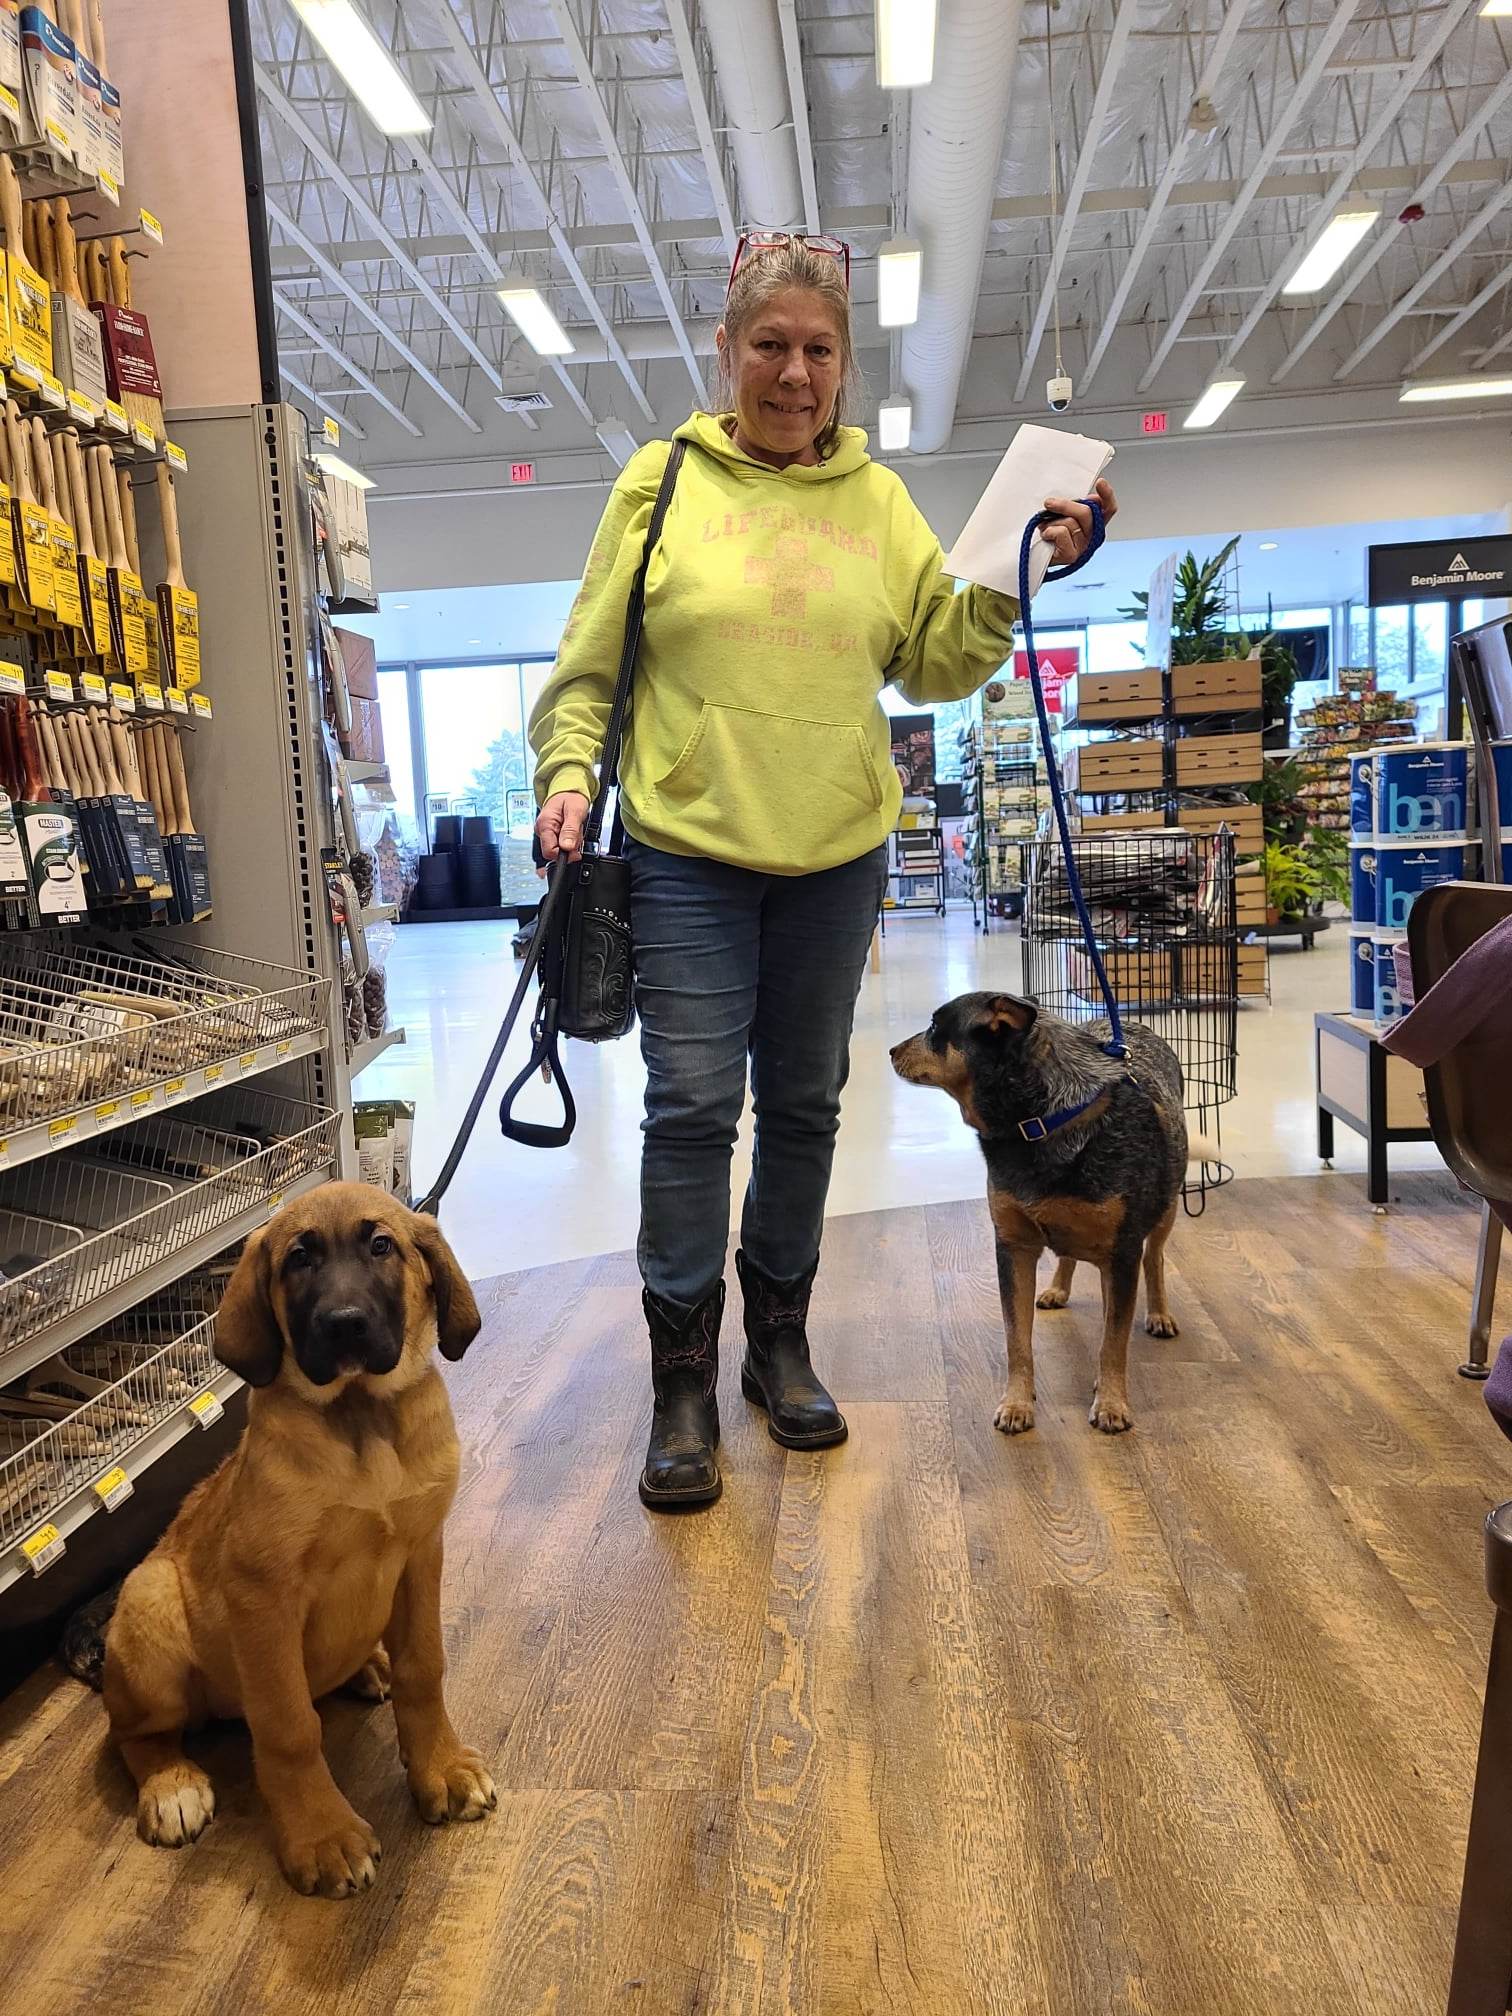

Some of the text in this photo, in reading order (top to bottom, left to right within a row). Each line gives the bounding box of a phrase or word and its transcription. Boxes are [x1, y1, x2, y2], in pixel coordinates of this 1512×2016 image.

[1144, 413, 1166, 431] EXIT
[512, 463, 532, 481] EXIT
[1411, 570, 1505, 587] Benjamin Moore
[1389, 783, 1461, 833] ben
[39, 819, 62, 828] MASTER
[57, 914, 81, 924] BETTER
